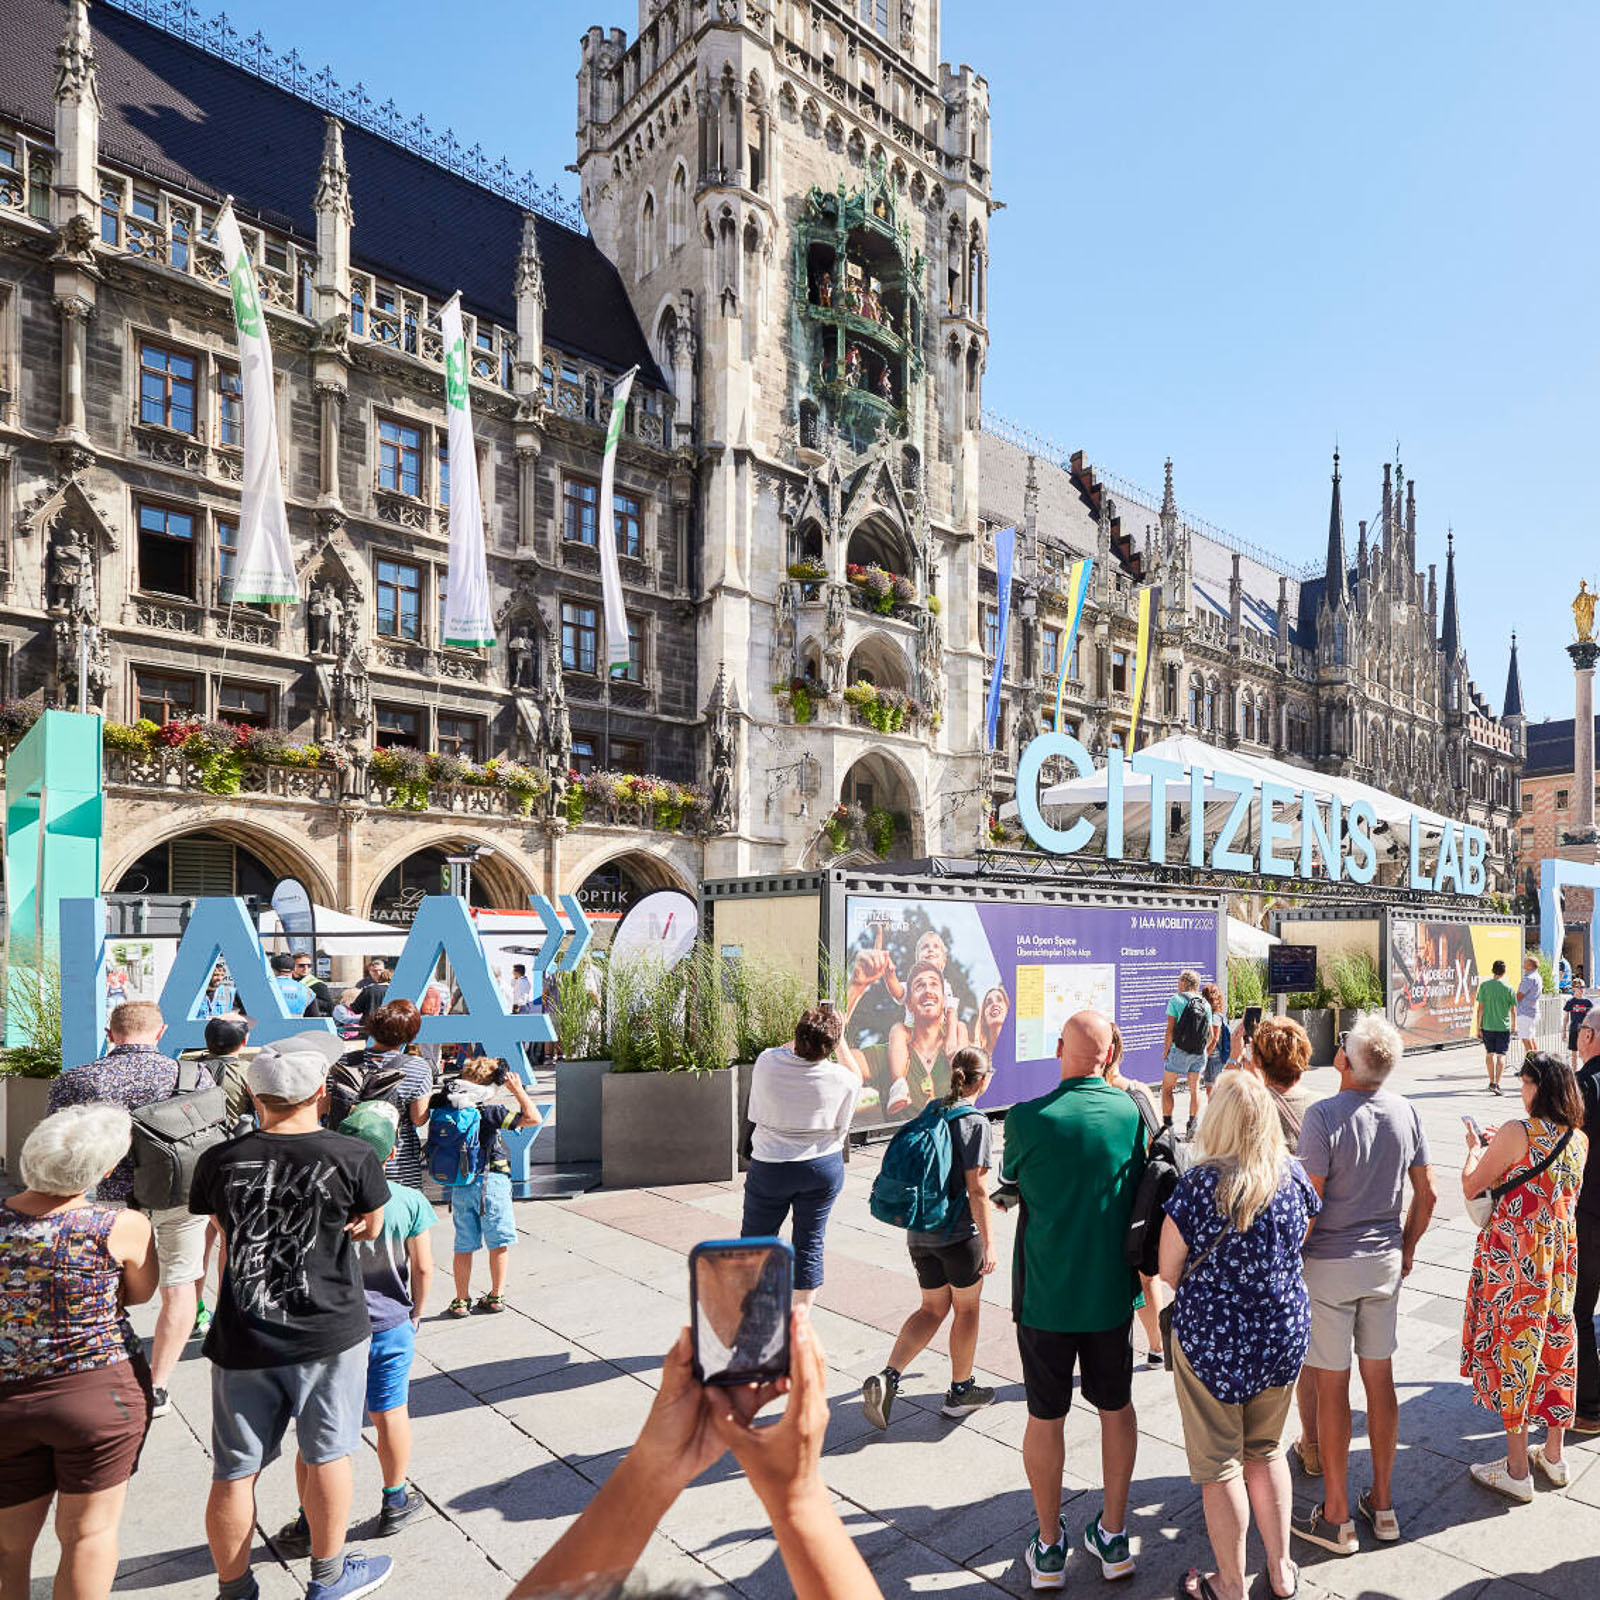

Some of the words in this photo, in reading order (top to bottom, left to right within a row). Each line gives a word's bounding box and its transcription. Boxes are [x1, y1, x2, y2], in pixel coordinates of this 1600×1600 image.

[1016, 732, 1377, 885] CITIZENS
[1410, 813, 1486, 897] LAB
[577, 890, 629, 903] OPTIK
[1139, 916, 1156, 929] IAA
[1156, 917, 1193, 929] MOBILITY
[1016, 935, 1031, 945] IAA
[1032, 935, 1054, 947] Open
[1055, 935, 1077, 947] Space
